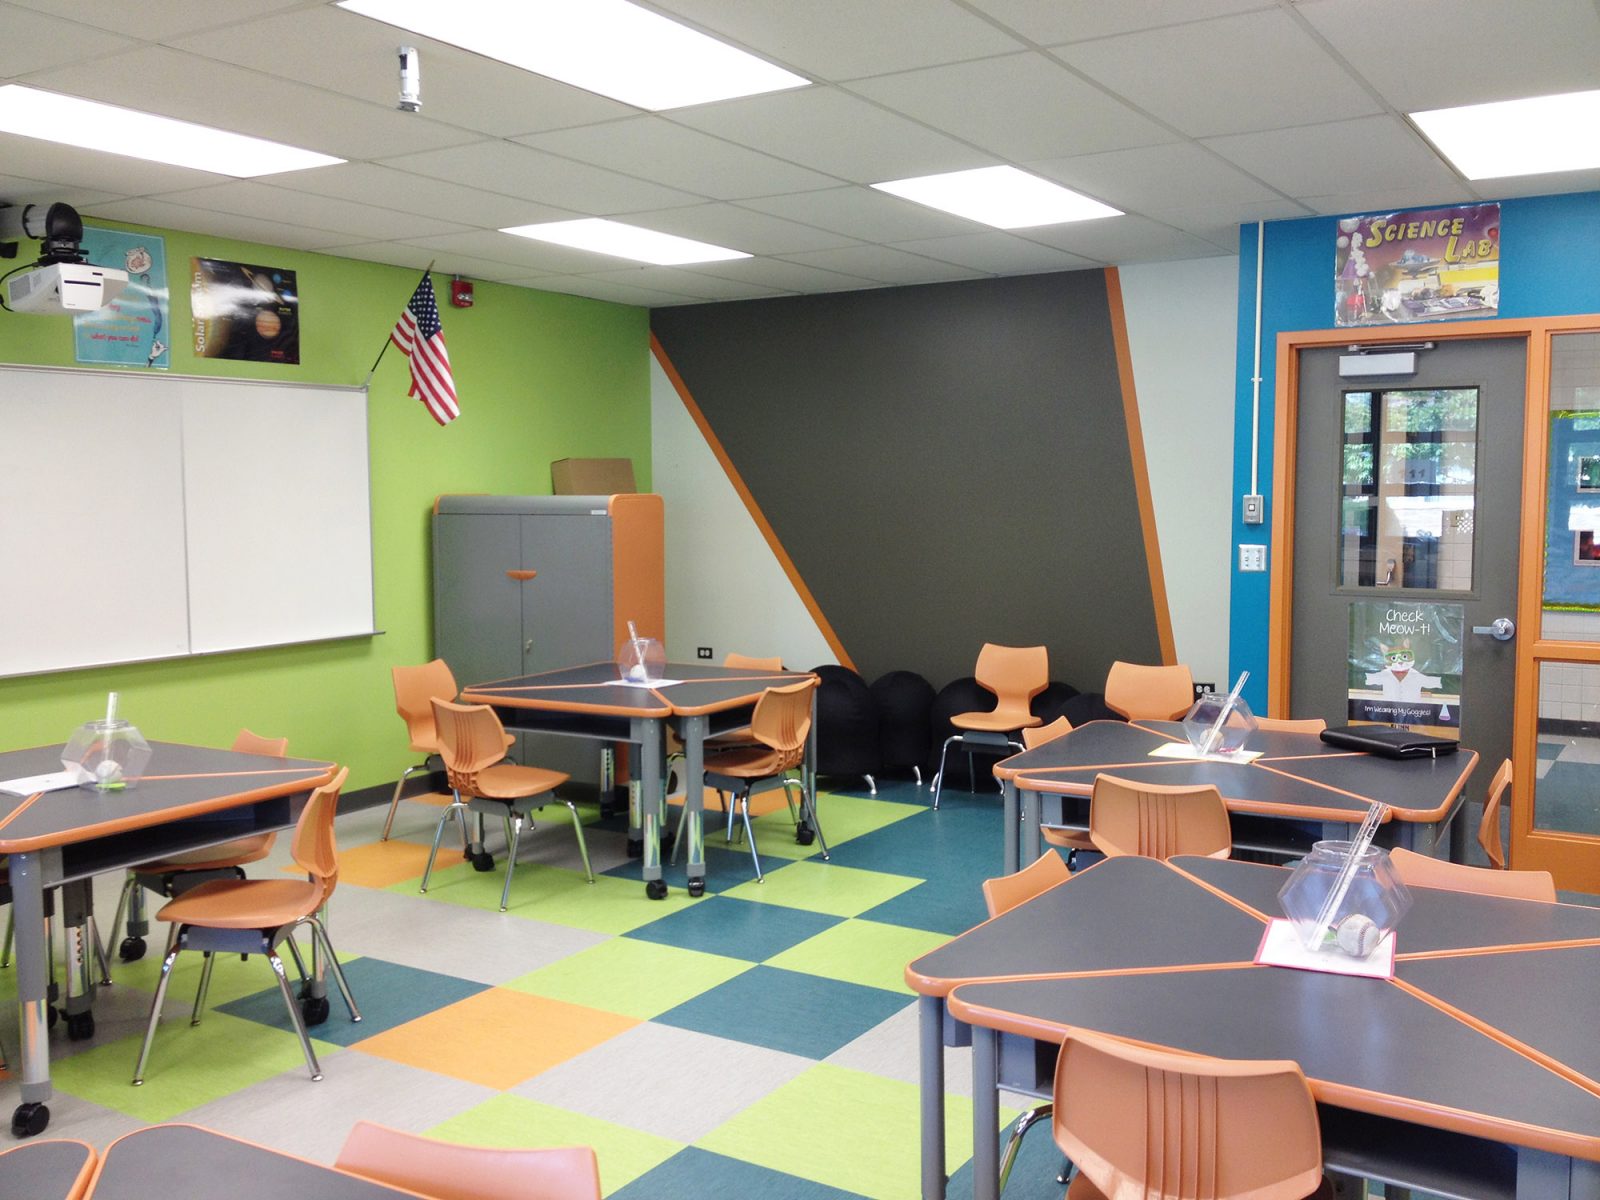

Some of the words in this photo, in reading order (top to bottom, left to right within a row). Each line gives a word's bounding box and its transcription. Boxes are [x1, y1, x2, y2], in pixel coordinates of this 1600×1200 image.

[1365, 217, 1465, 248] SCIENCE
[1443, 235, 1493, 263] LAB
[194, 319, 206, 352] Solar
[1386, 608, 1425, 622] Check
[1374, 706, 1398, 716] Wearing
[1398, 708, 1407, 716] My
